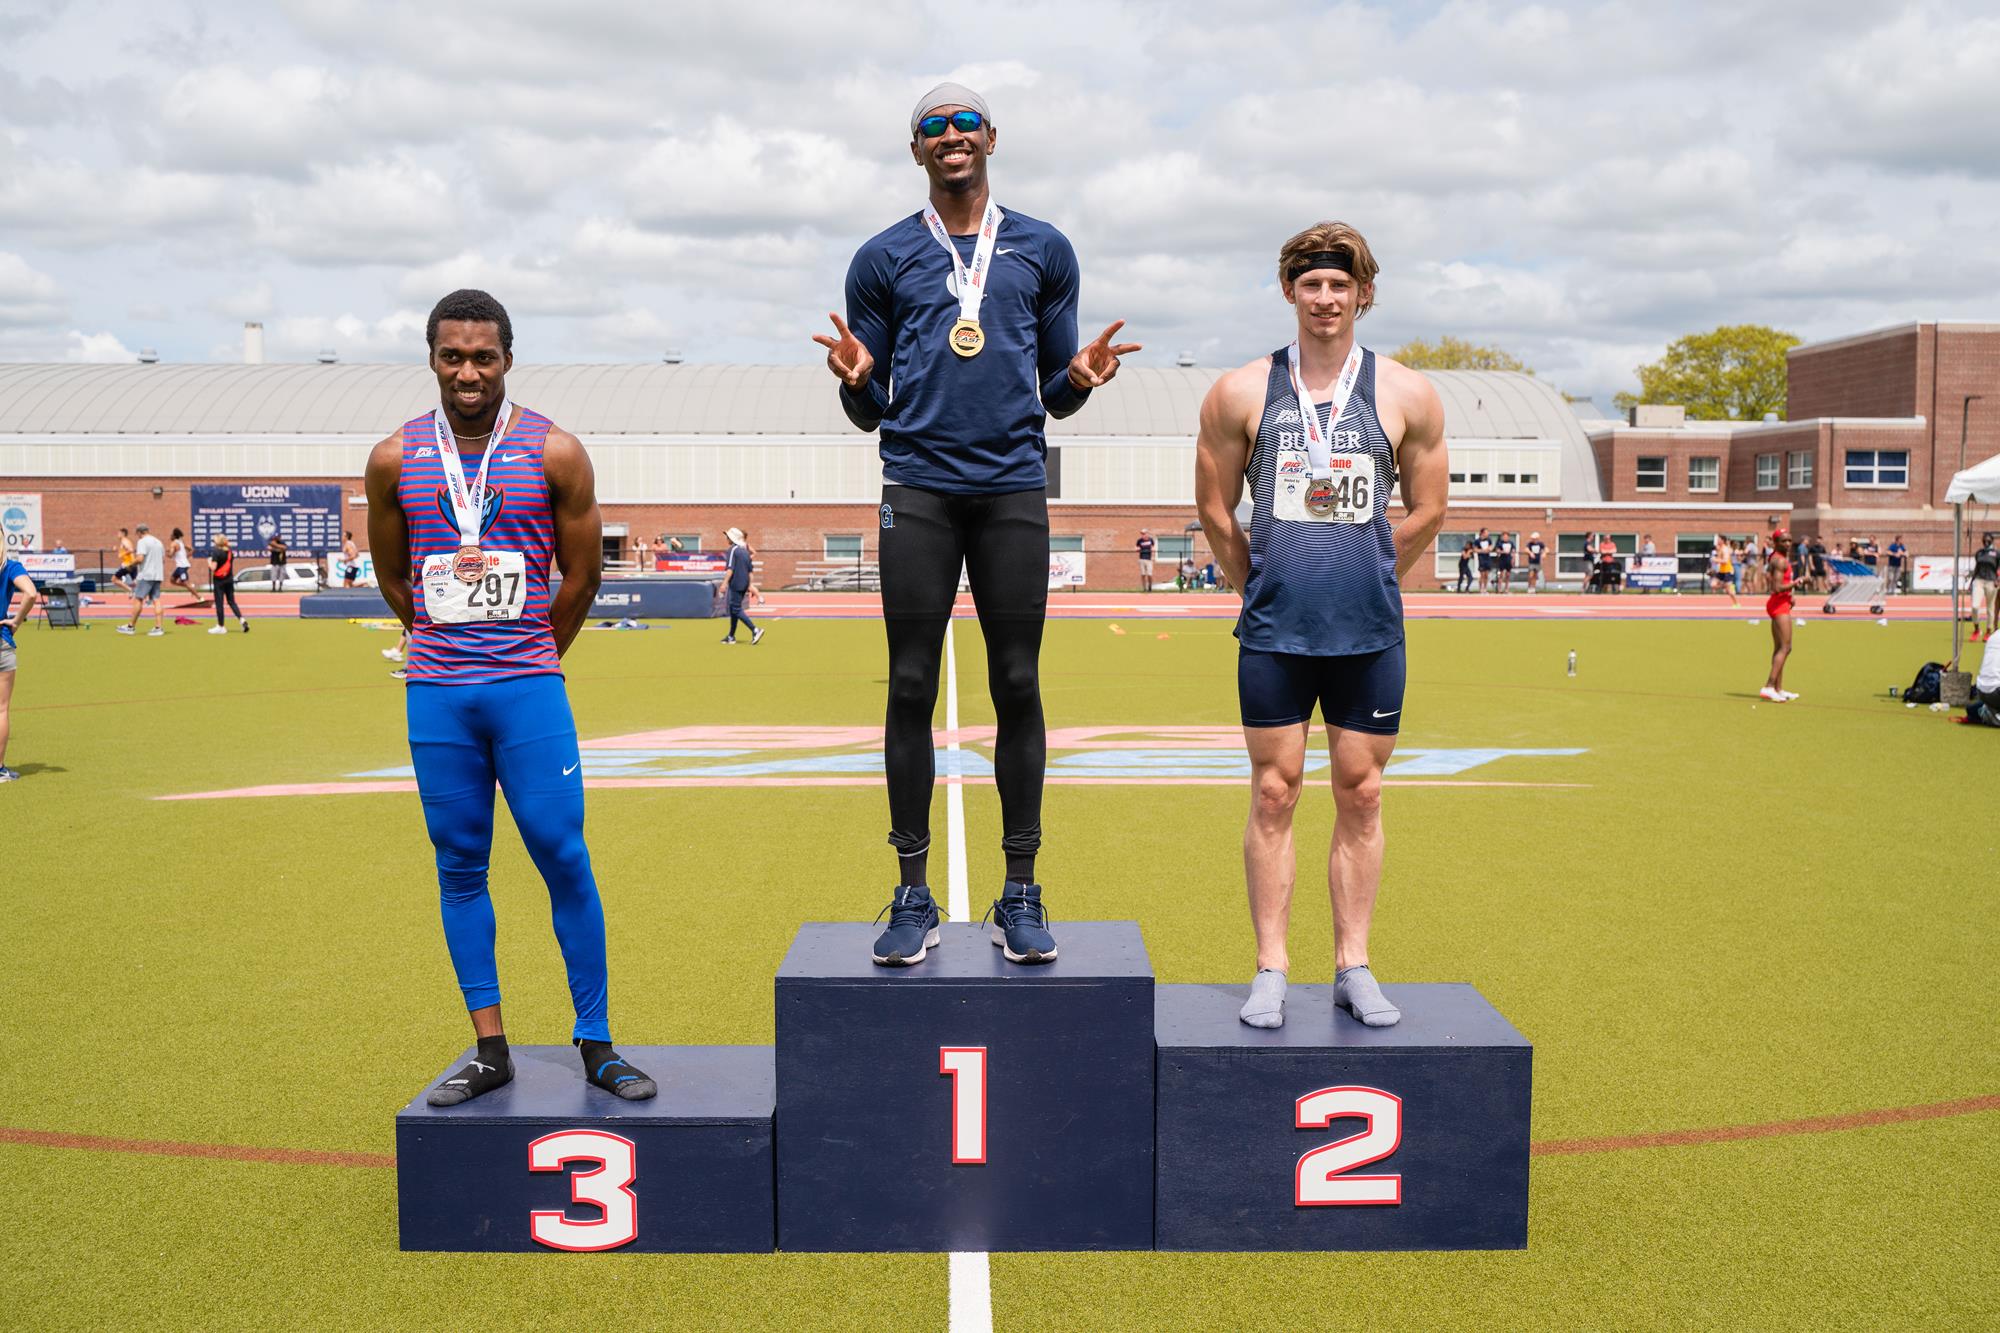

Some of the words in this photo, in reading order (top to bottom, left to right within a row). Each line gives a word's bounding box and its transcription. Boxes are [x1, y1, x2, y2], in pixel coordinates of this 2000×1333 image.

[1278, 431, 1361, 450] BUER
[242, 486, 289, 498] UCONN
[1330, 476, 1369, 510] 46
[880, 503, 894, 529] G
[7, 534, 34, 546] 017
[486, 555, 500, 567] le
[468, 572, 520, 608] 297
[344, 747, 1588, 777] EAST
[939, 1046, 987, 1164] 1
[1295, 1085, 1402, 1206] 2
[528, 1129, 637, 1252] 3
